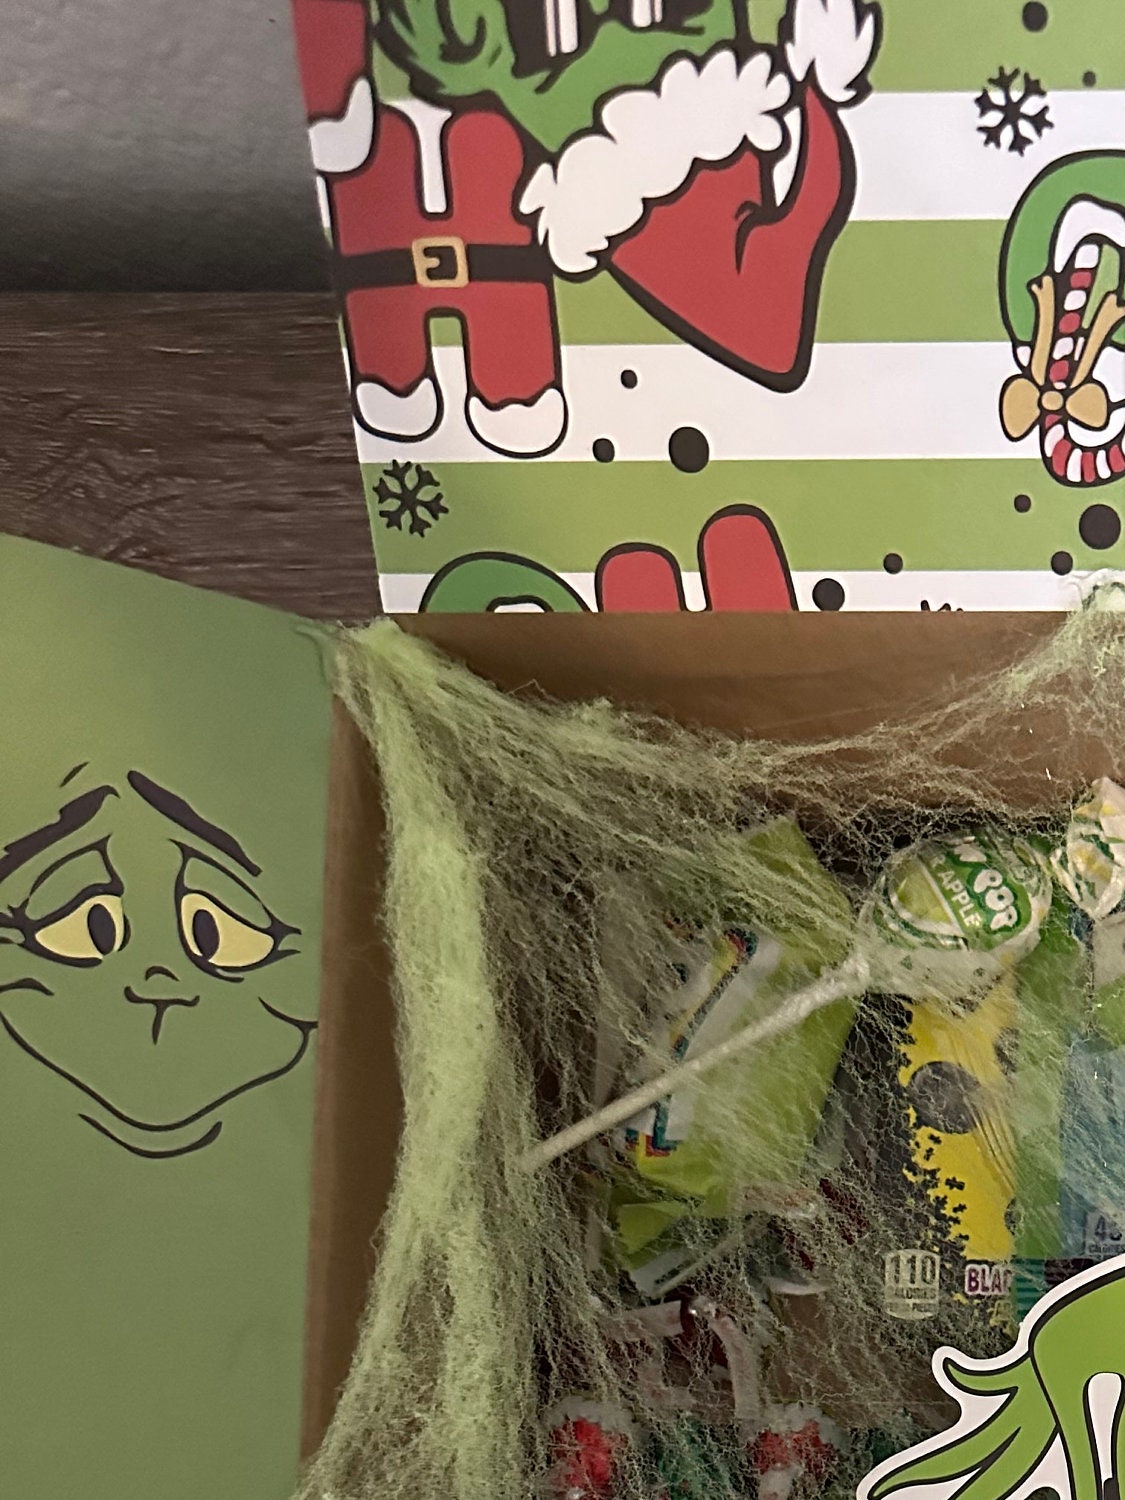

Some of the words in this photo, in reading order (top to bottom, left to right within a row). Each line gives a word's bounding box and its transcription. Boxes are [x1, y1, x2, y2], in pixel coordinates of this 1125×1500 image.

[937, 868, 983, 928] APPLE
[973, 868, 1018, 932] POP
[890, 1254, 937, 1285] 110
